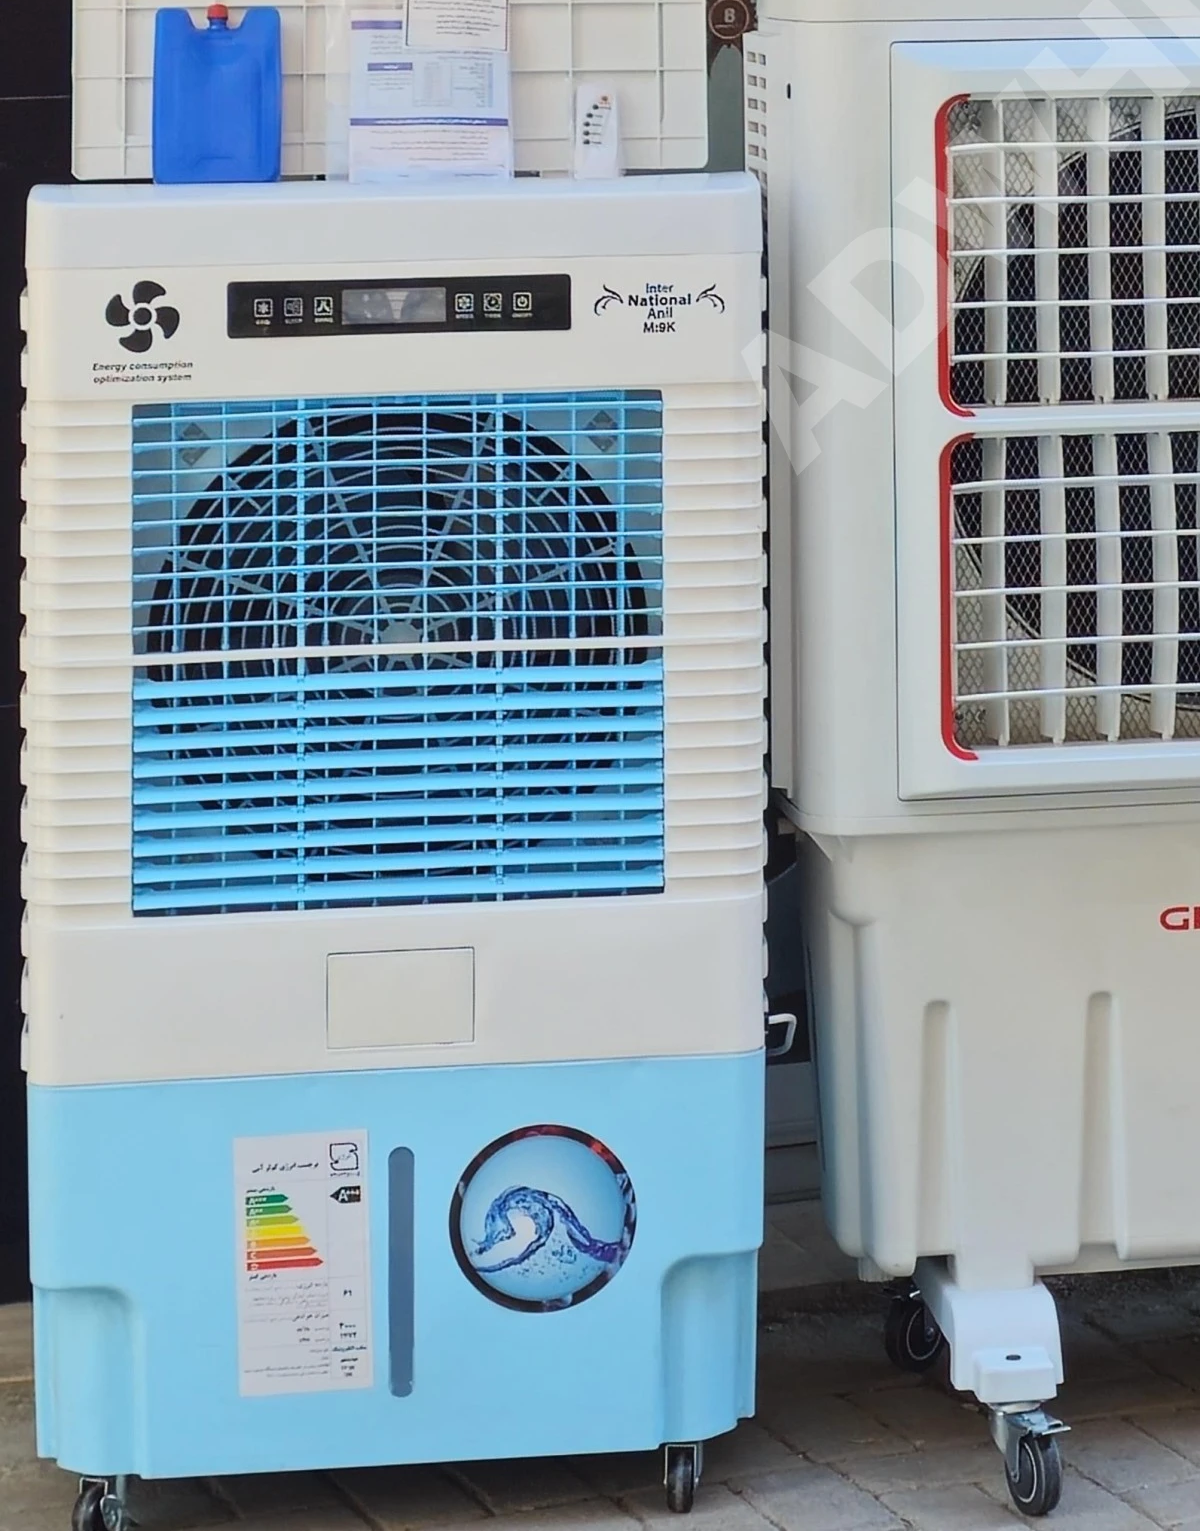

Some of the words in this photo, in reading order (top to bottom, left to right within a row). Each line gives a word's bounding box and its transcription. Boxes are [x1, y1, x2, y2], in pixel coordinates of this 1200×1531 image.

[645, 283, 674, 295] Inter
[627, 292, 691, 308] National
[646, 307, 673, 320] Anil
[643, 321, 676, 335] M:9K
[92, 362, 127, 373] Energy
[129, 360, 194, 371] consumption
[93, 374, 156, 385] optimization
[157, 373, 192, 383] system
